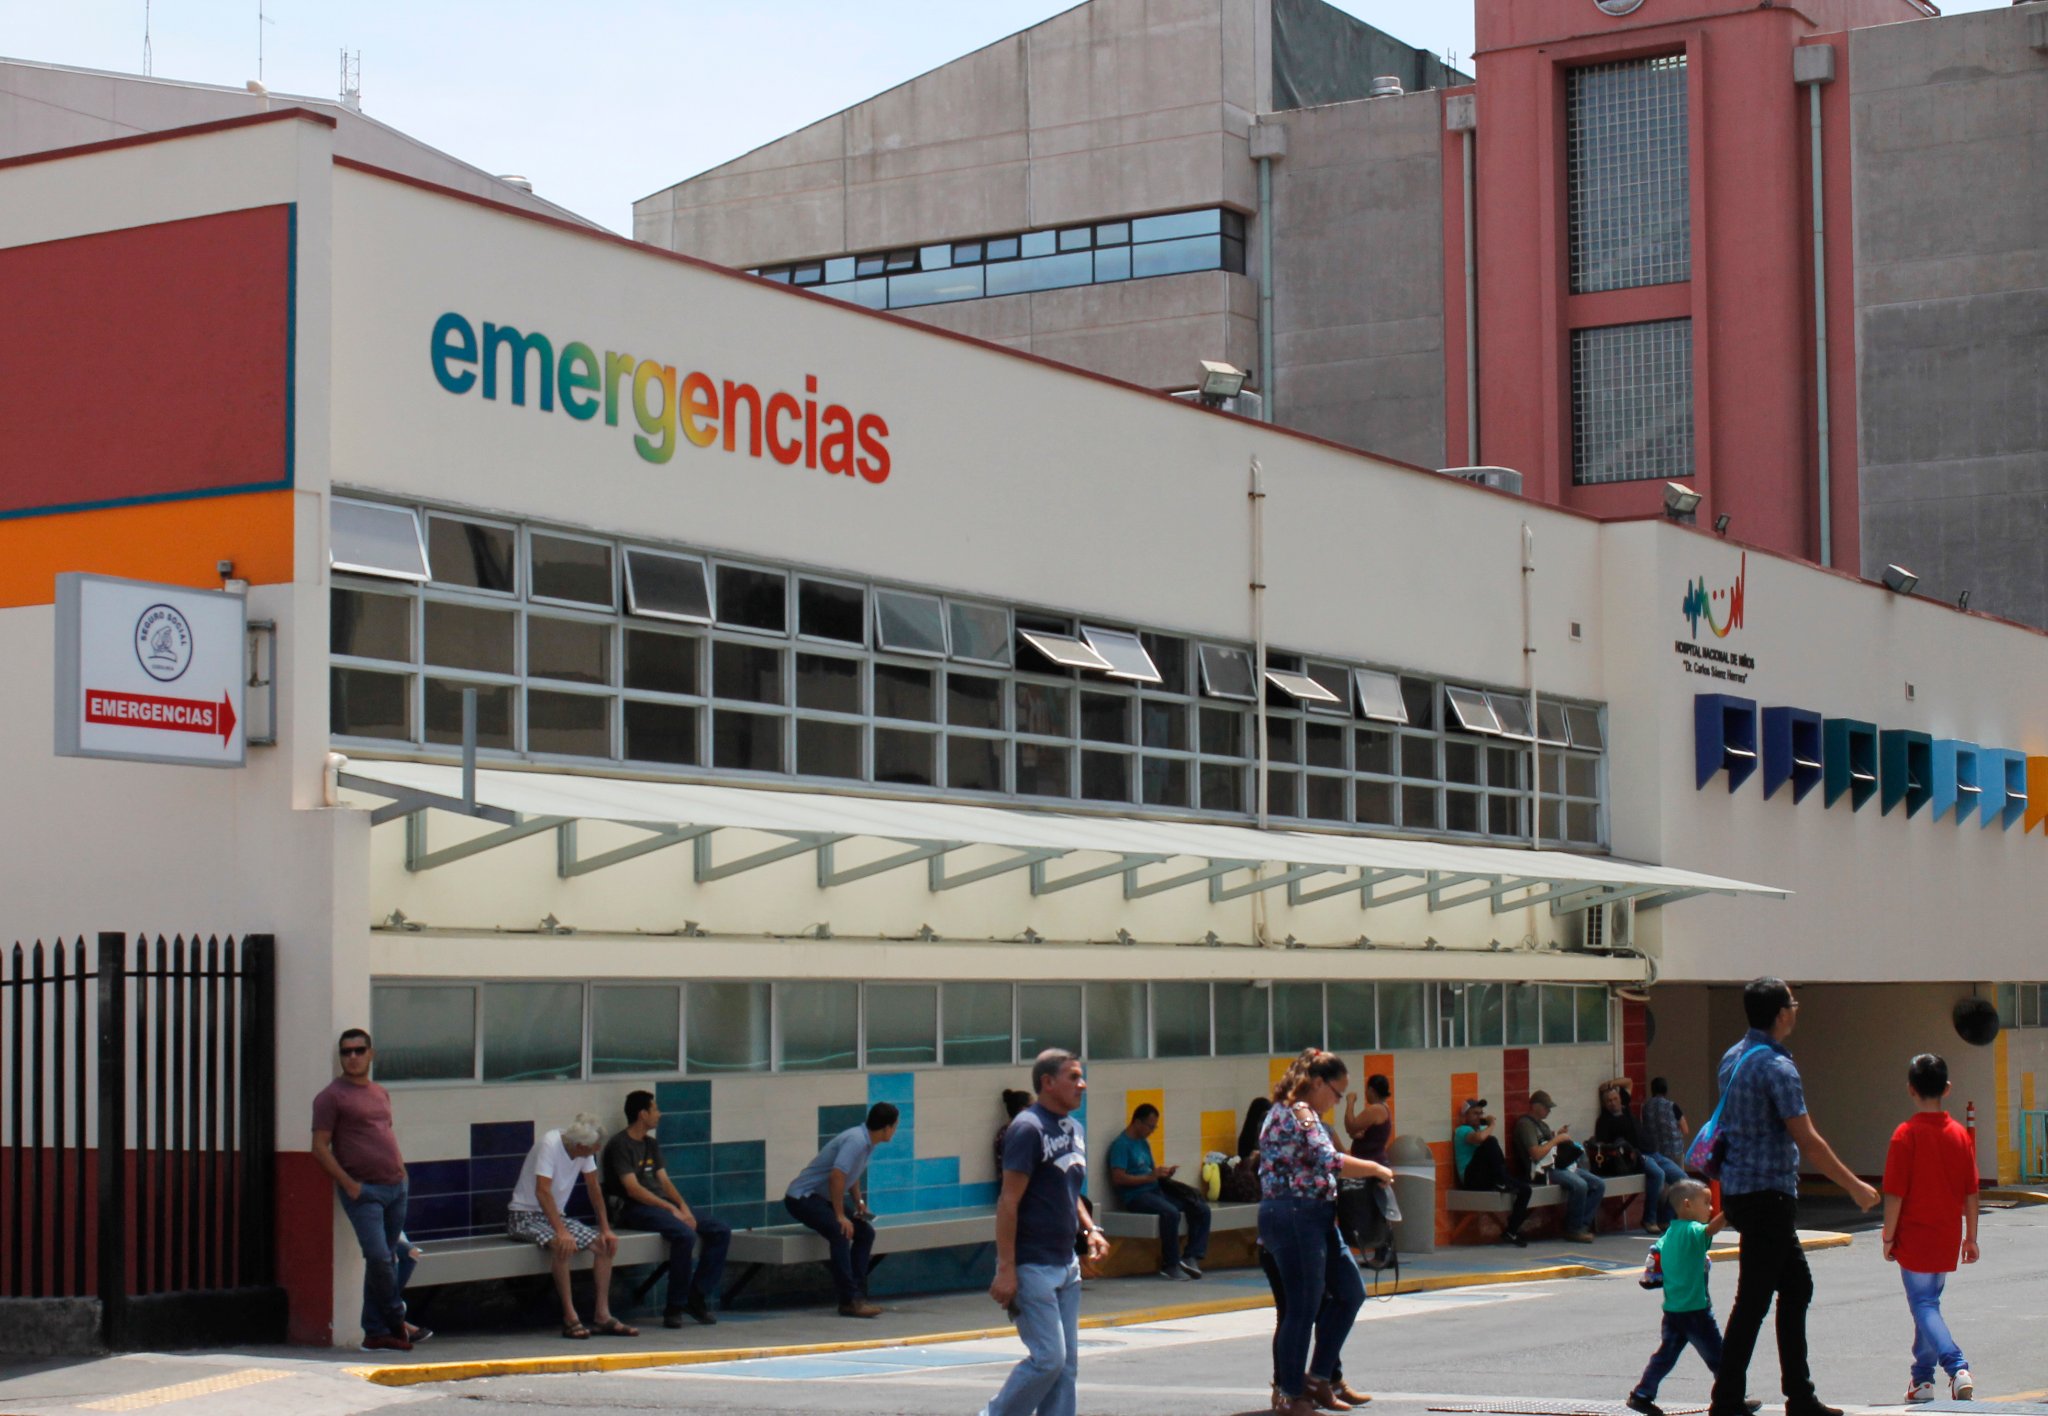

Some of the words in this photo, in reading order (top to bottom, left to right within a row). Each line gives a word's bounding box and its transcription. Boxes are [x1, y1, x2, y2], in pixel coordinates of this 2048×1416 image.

[431, 312, 891, 484] emergencias
[1675, 640, 1702, 658] HOSPITAL
[1702, 647, 1729, 664] NACIONAL
[1730, 653, 1738, 666] DE
[91, 697, 213, 726] EMERGENCIAS
